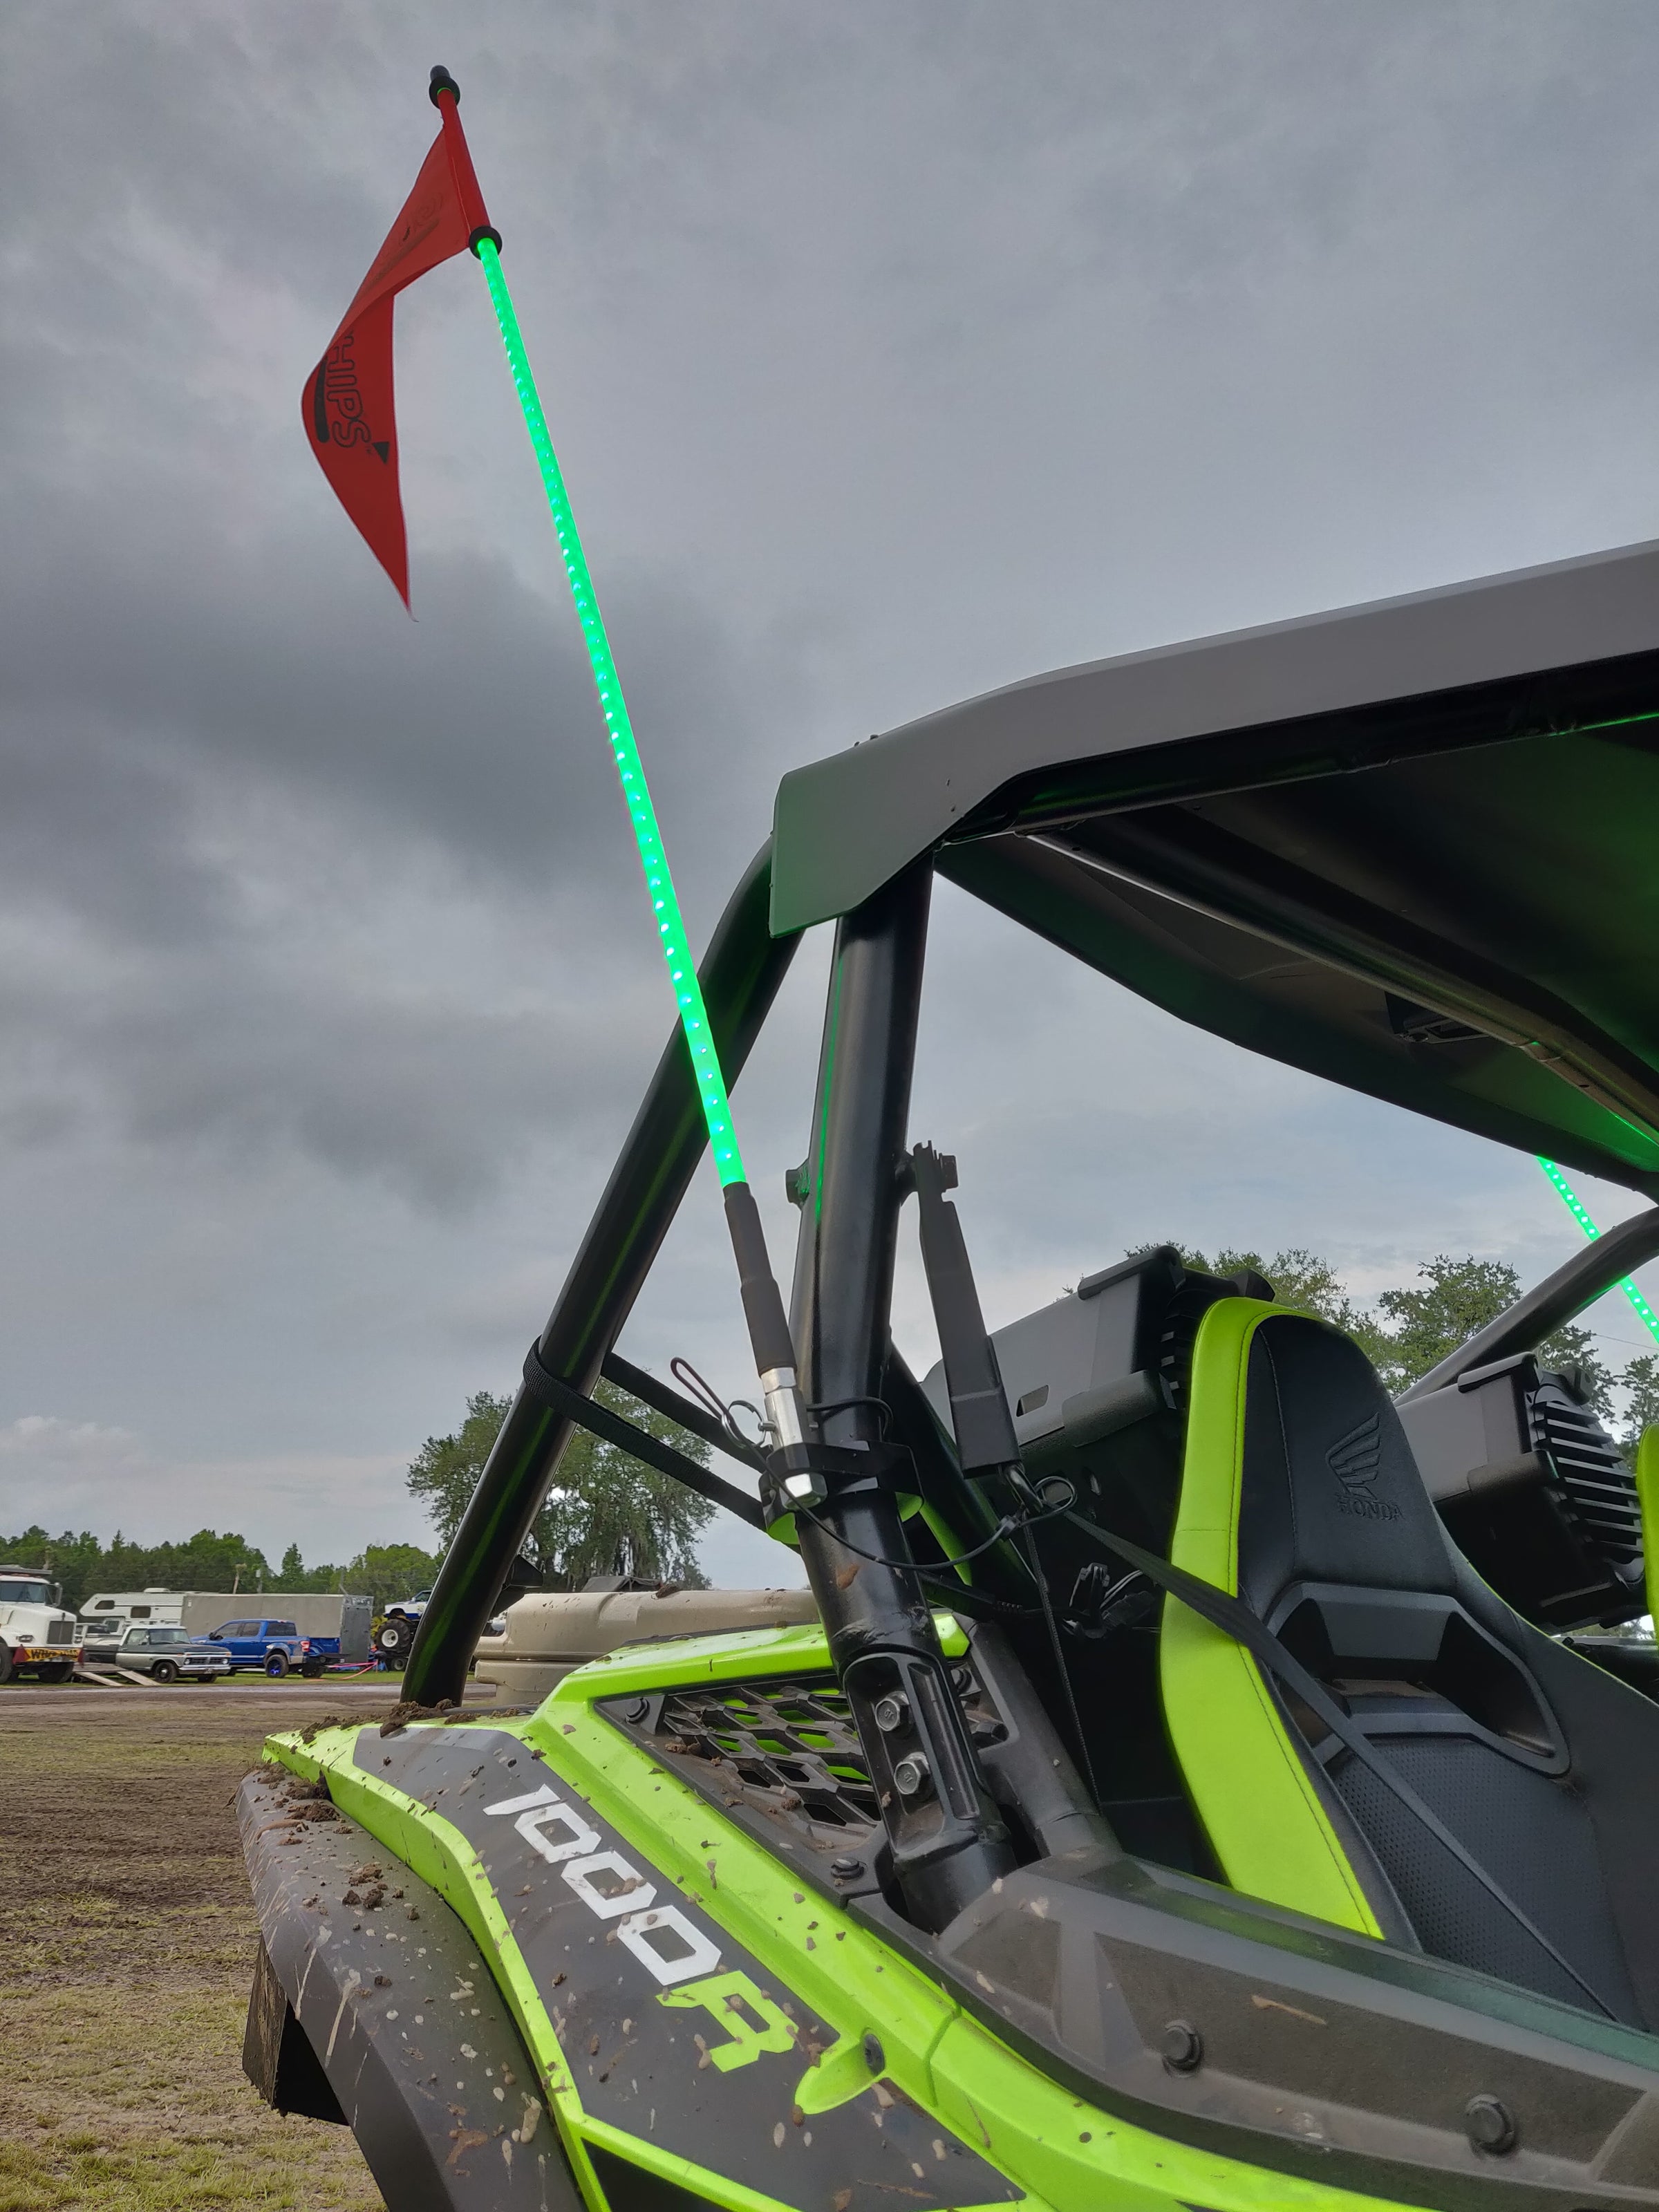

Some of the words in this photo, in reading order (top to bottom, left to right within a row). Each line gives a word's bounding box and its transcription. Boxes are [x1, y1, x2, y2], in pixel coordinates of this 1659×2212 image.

[326, 331, 371, 448] HIPS
[1335, 1492, 1405, 1521] HONDA
[483, 1784, 799, 2073] 1000R
